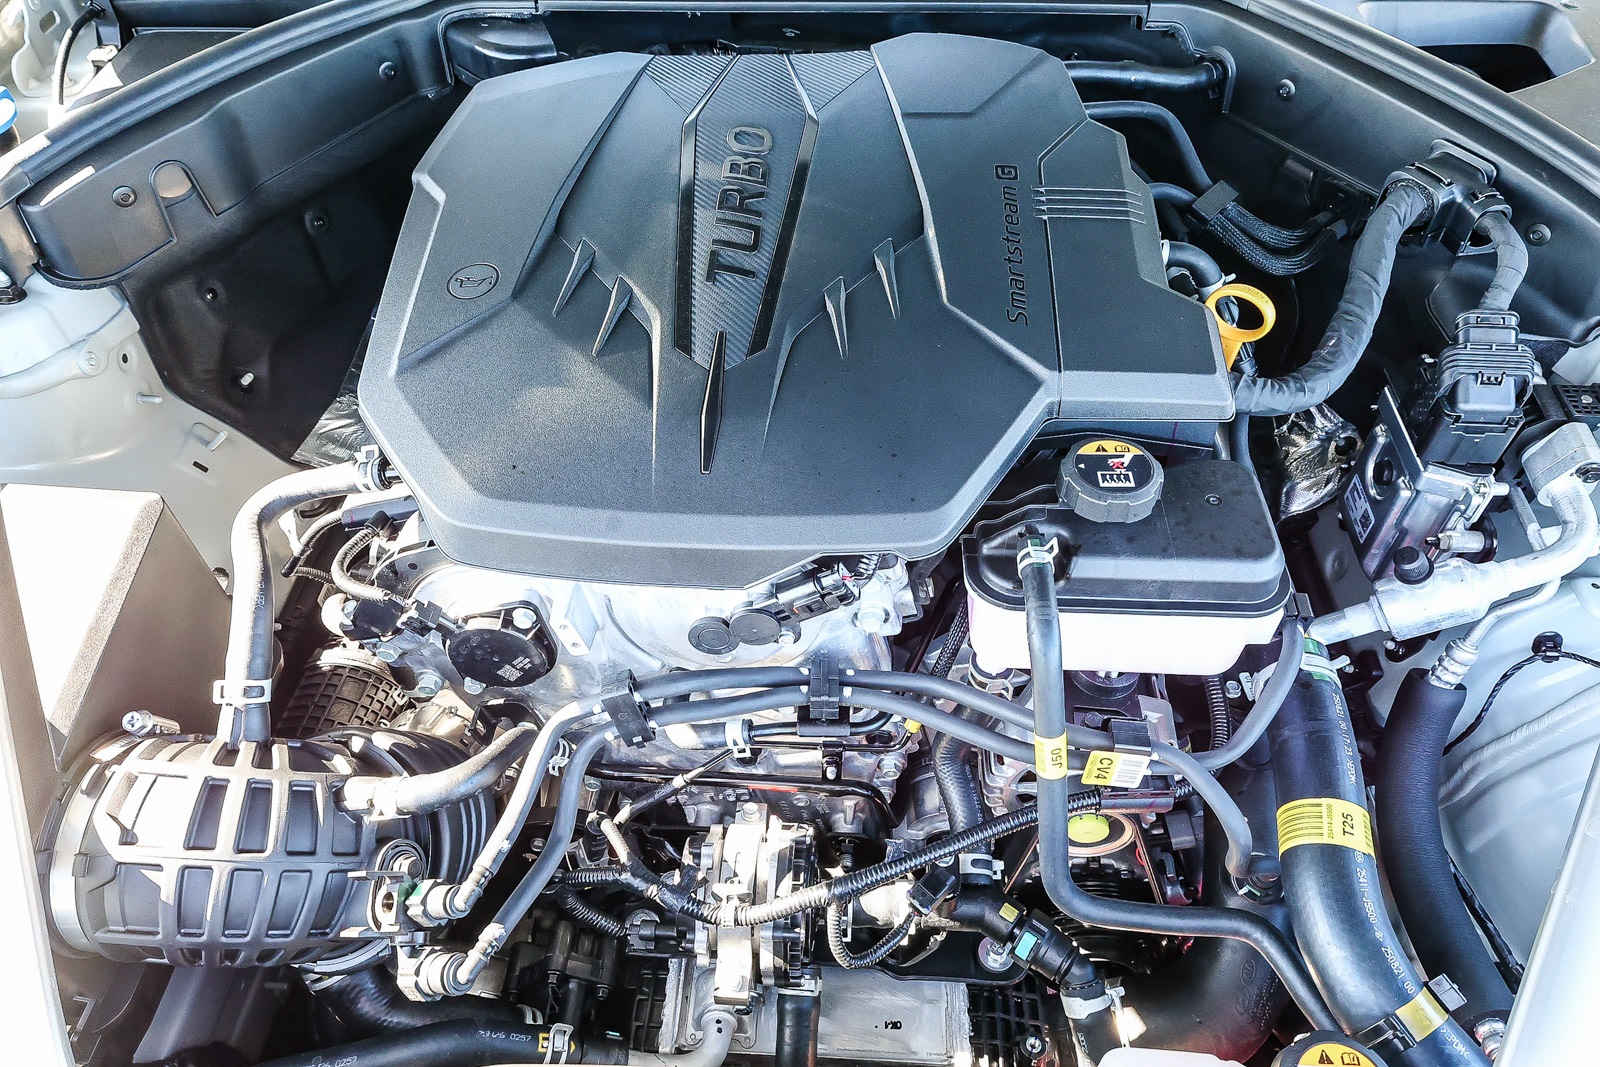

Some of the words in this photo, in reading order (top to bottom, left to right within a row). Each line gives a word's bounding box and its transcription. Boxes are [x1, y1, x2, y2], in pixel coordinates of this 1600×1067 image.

[706, 126, 773, 285] TURBO
[1002, 185, 1028, 327] Smartstream
[1050, 747, 1063, 769] J50
[1093, 757, 1114, 781] CV4
[1341, 812, 1355, 837] T25
[1356, 867, 1378, 924] 25411-J5500
[1381, 945, 1406, 980] 250821
